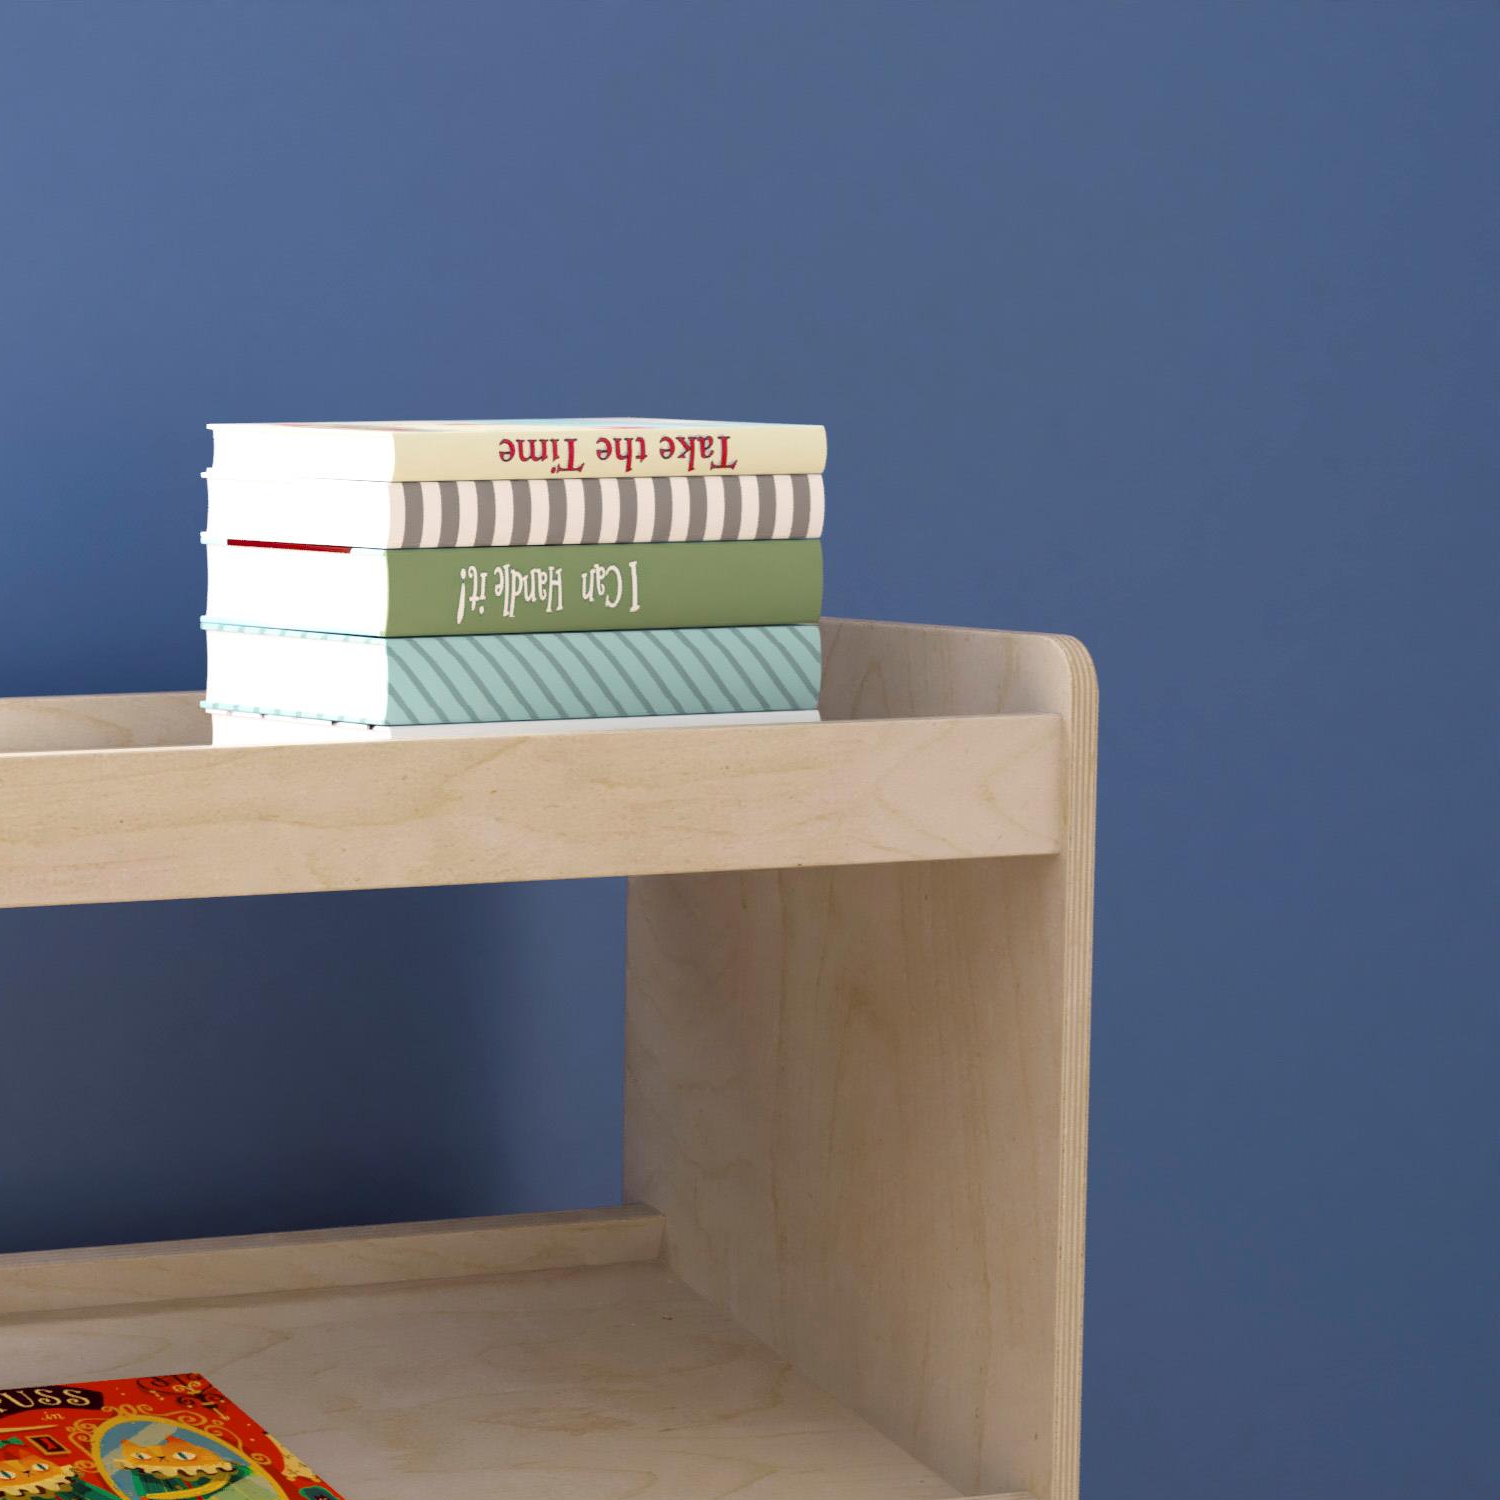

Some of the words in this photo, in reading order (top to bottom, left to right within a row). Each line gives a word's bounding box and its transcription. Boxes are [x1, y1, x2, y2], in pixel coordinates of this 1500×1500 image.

[498, 438, 585, 474] Time
[596, 437, 648, 472] the
[659, 435, 738, 472] Take
[457, 565, 488, 625] it!
[494, 563, 564, 618] Handle
[581, 563, 623, 608] Can
[628, 560, 641, 613] I
